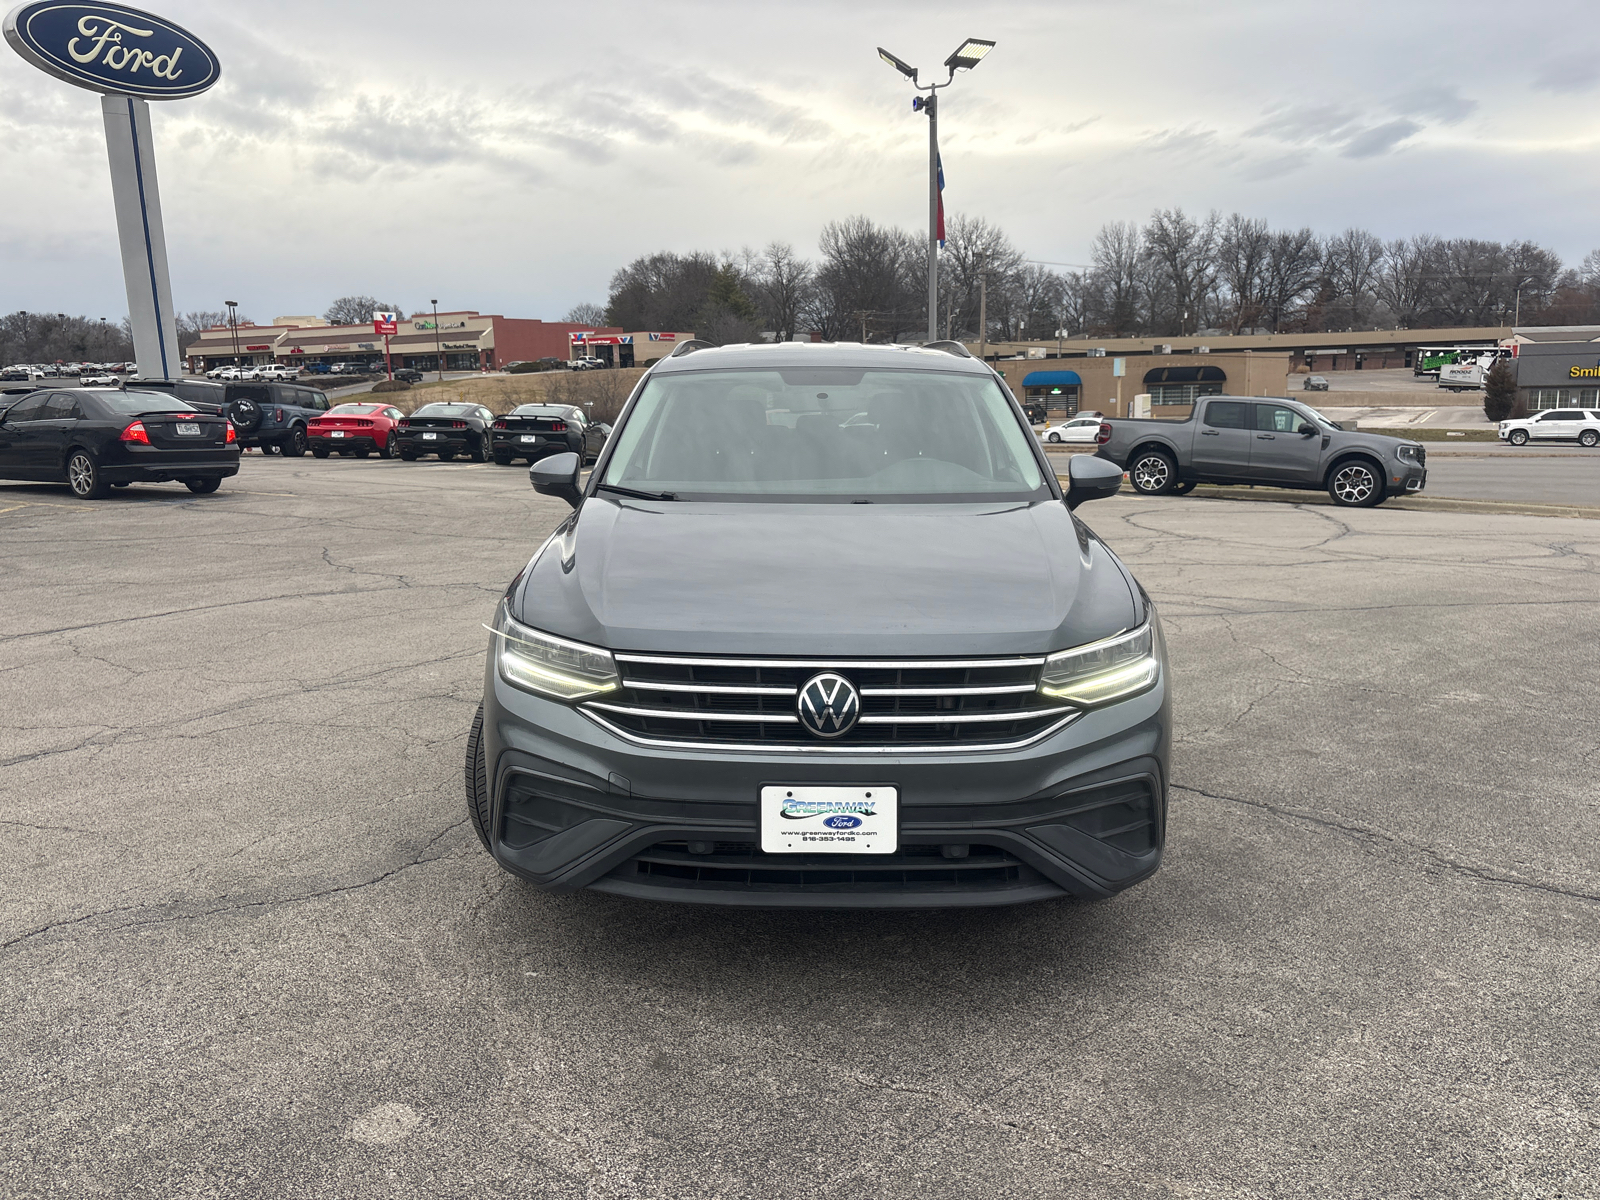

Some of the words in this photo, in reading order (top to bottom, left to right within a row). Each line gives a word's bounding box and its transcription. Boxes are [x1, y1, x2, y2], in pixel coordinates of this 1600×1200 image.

[67, 15, 183, 81] Ford
[782, 799, 876, 814] GREENWAY
[831, 816, 854, 828] Ford
